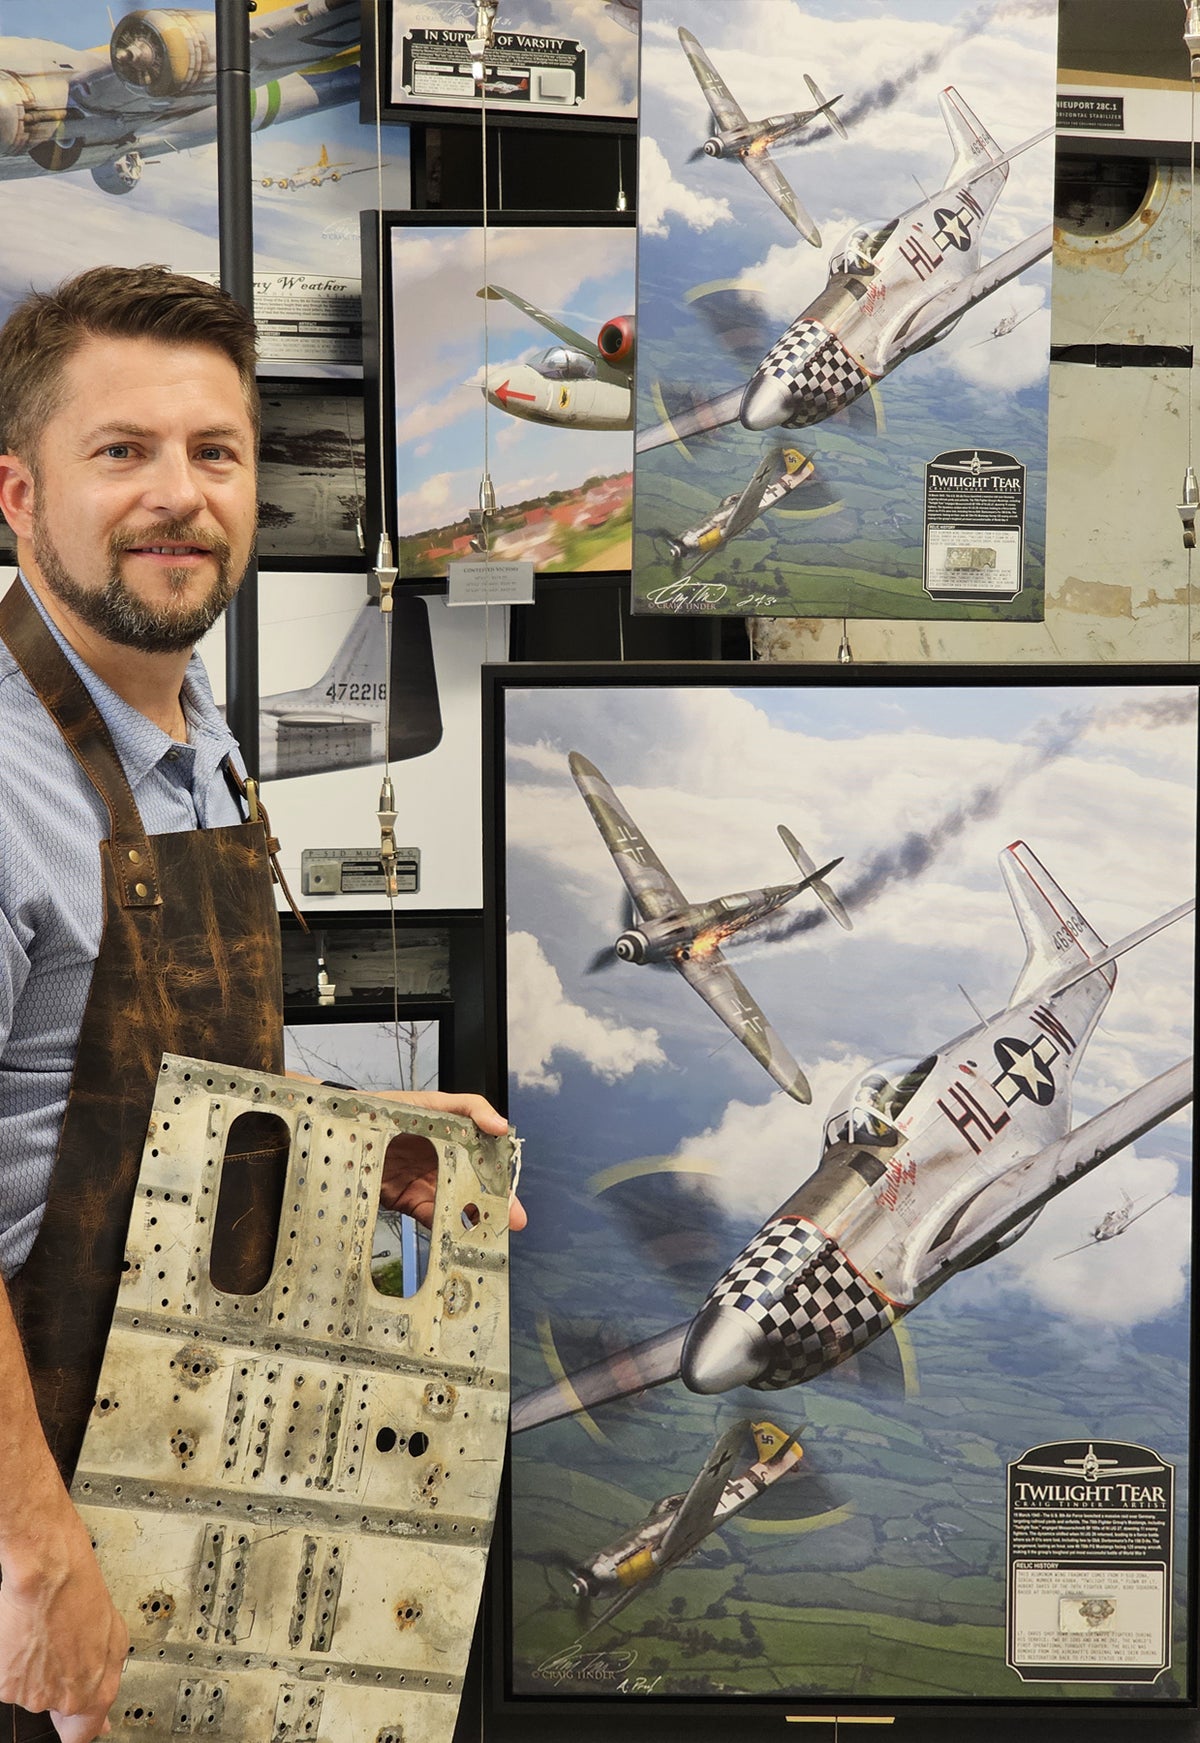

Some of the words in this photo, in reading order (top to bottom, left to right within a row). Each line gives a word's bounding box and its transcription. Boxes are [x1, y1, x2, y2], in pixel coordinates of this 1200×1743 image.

[425, 30, 439, 40] IN
[442, 31, 476, 43] SUPP
[498, 36, 513, 46] OF
[517, 36, 564, 50] VARSITY
[1056, 101, 1095, 110] NIEUPORT
[899, 235, 944, 282] HL
[277, 276, 347, 292] Weather
[929, 475, 989, 488] TWILIGHT
[990, 476, 1021, 489] TEAR
[326, 683, 387, 701] 472218
[1052, 915, 1088, 952] 463864
[937, 1081, 1011, 1155] HL
[1015, 1482, 1114, 1502] TWILIGHT
[1116, 1484, 1166, 1502] TEAR
[576, 1670, 616, 1680] TINDER
